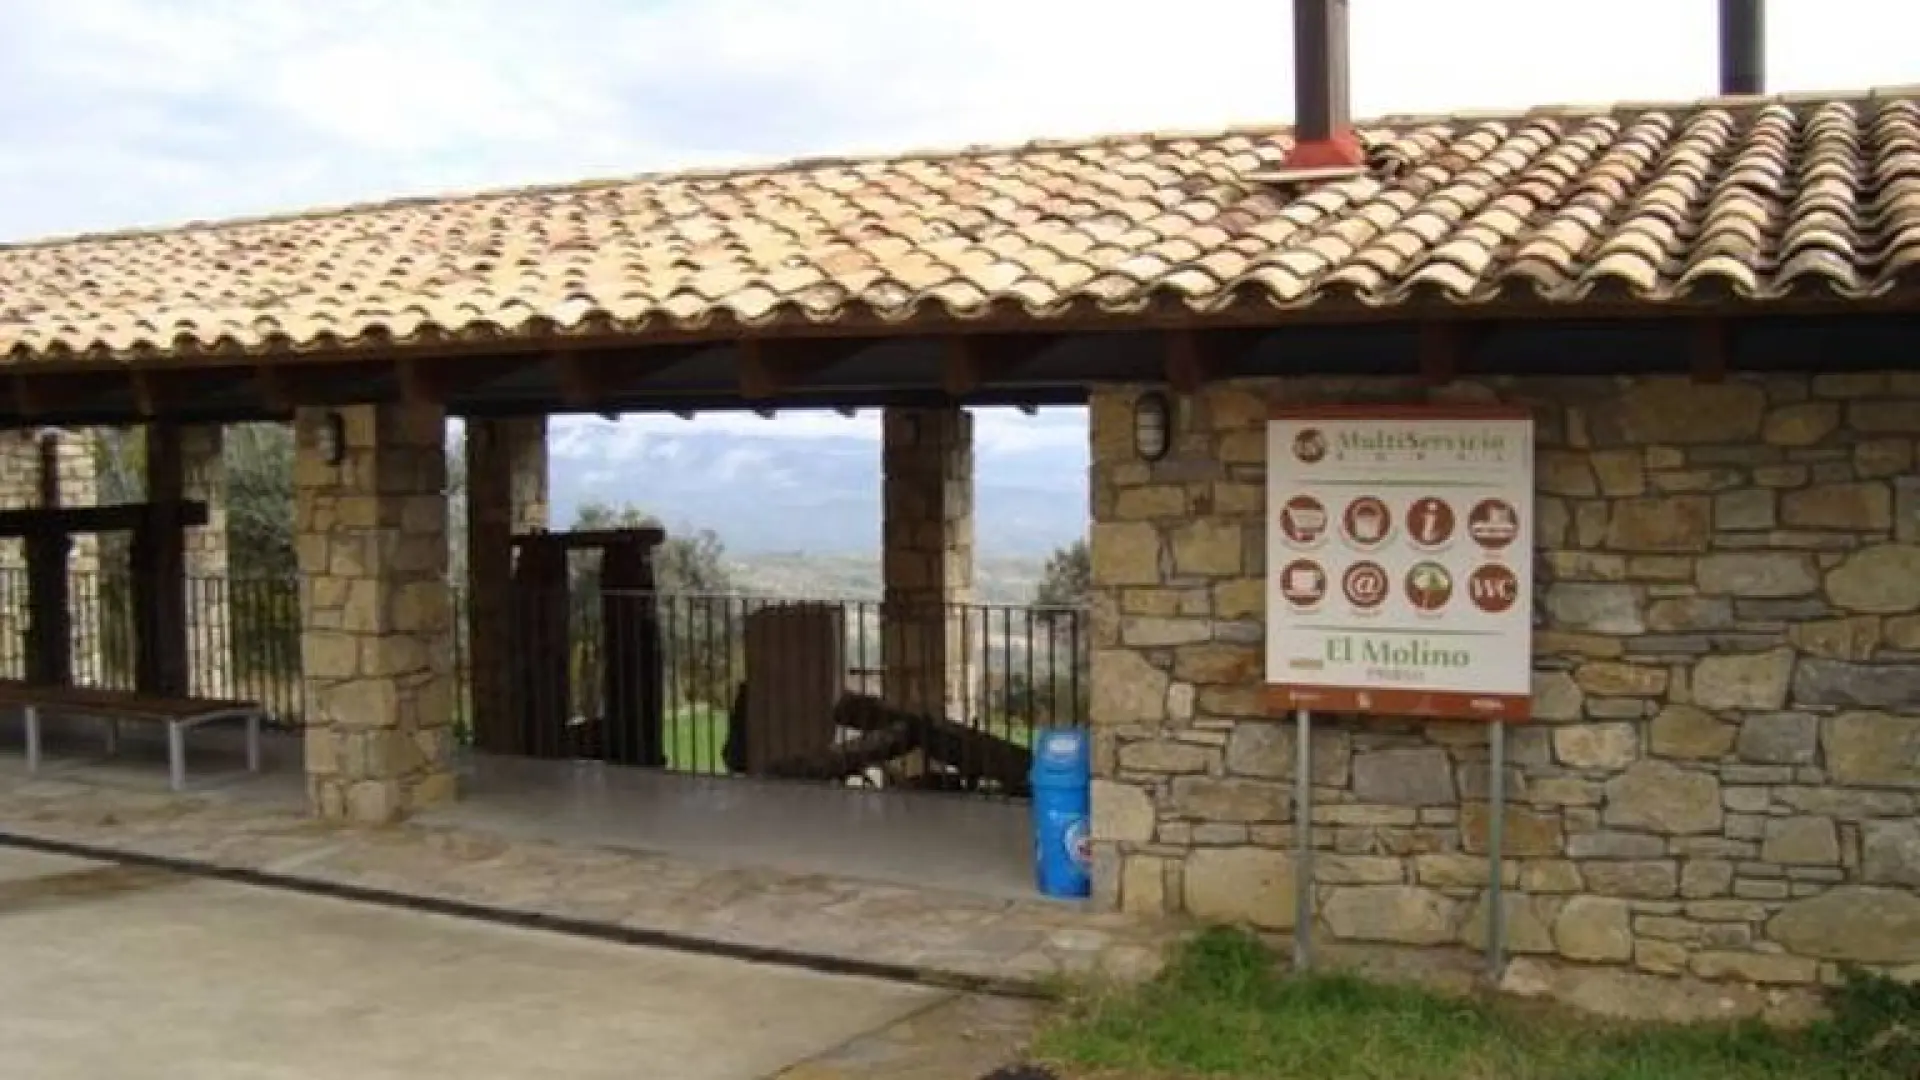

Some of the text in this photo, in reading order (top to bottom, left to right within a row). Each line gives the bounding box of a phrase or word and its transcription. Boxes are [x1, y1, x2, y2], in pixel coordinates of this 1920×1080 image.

[1473, 577, 1517, 601] WC
[1326, 637, 1471, 668] El Molino
